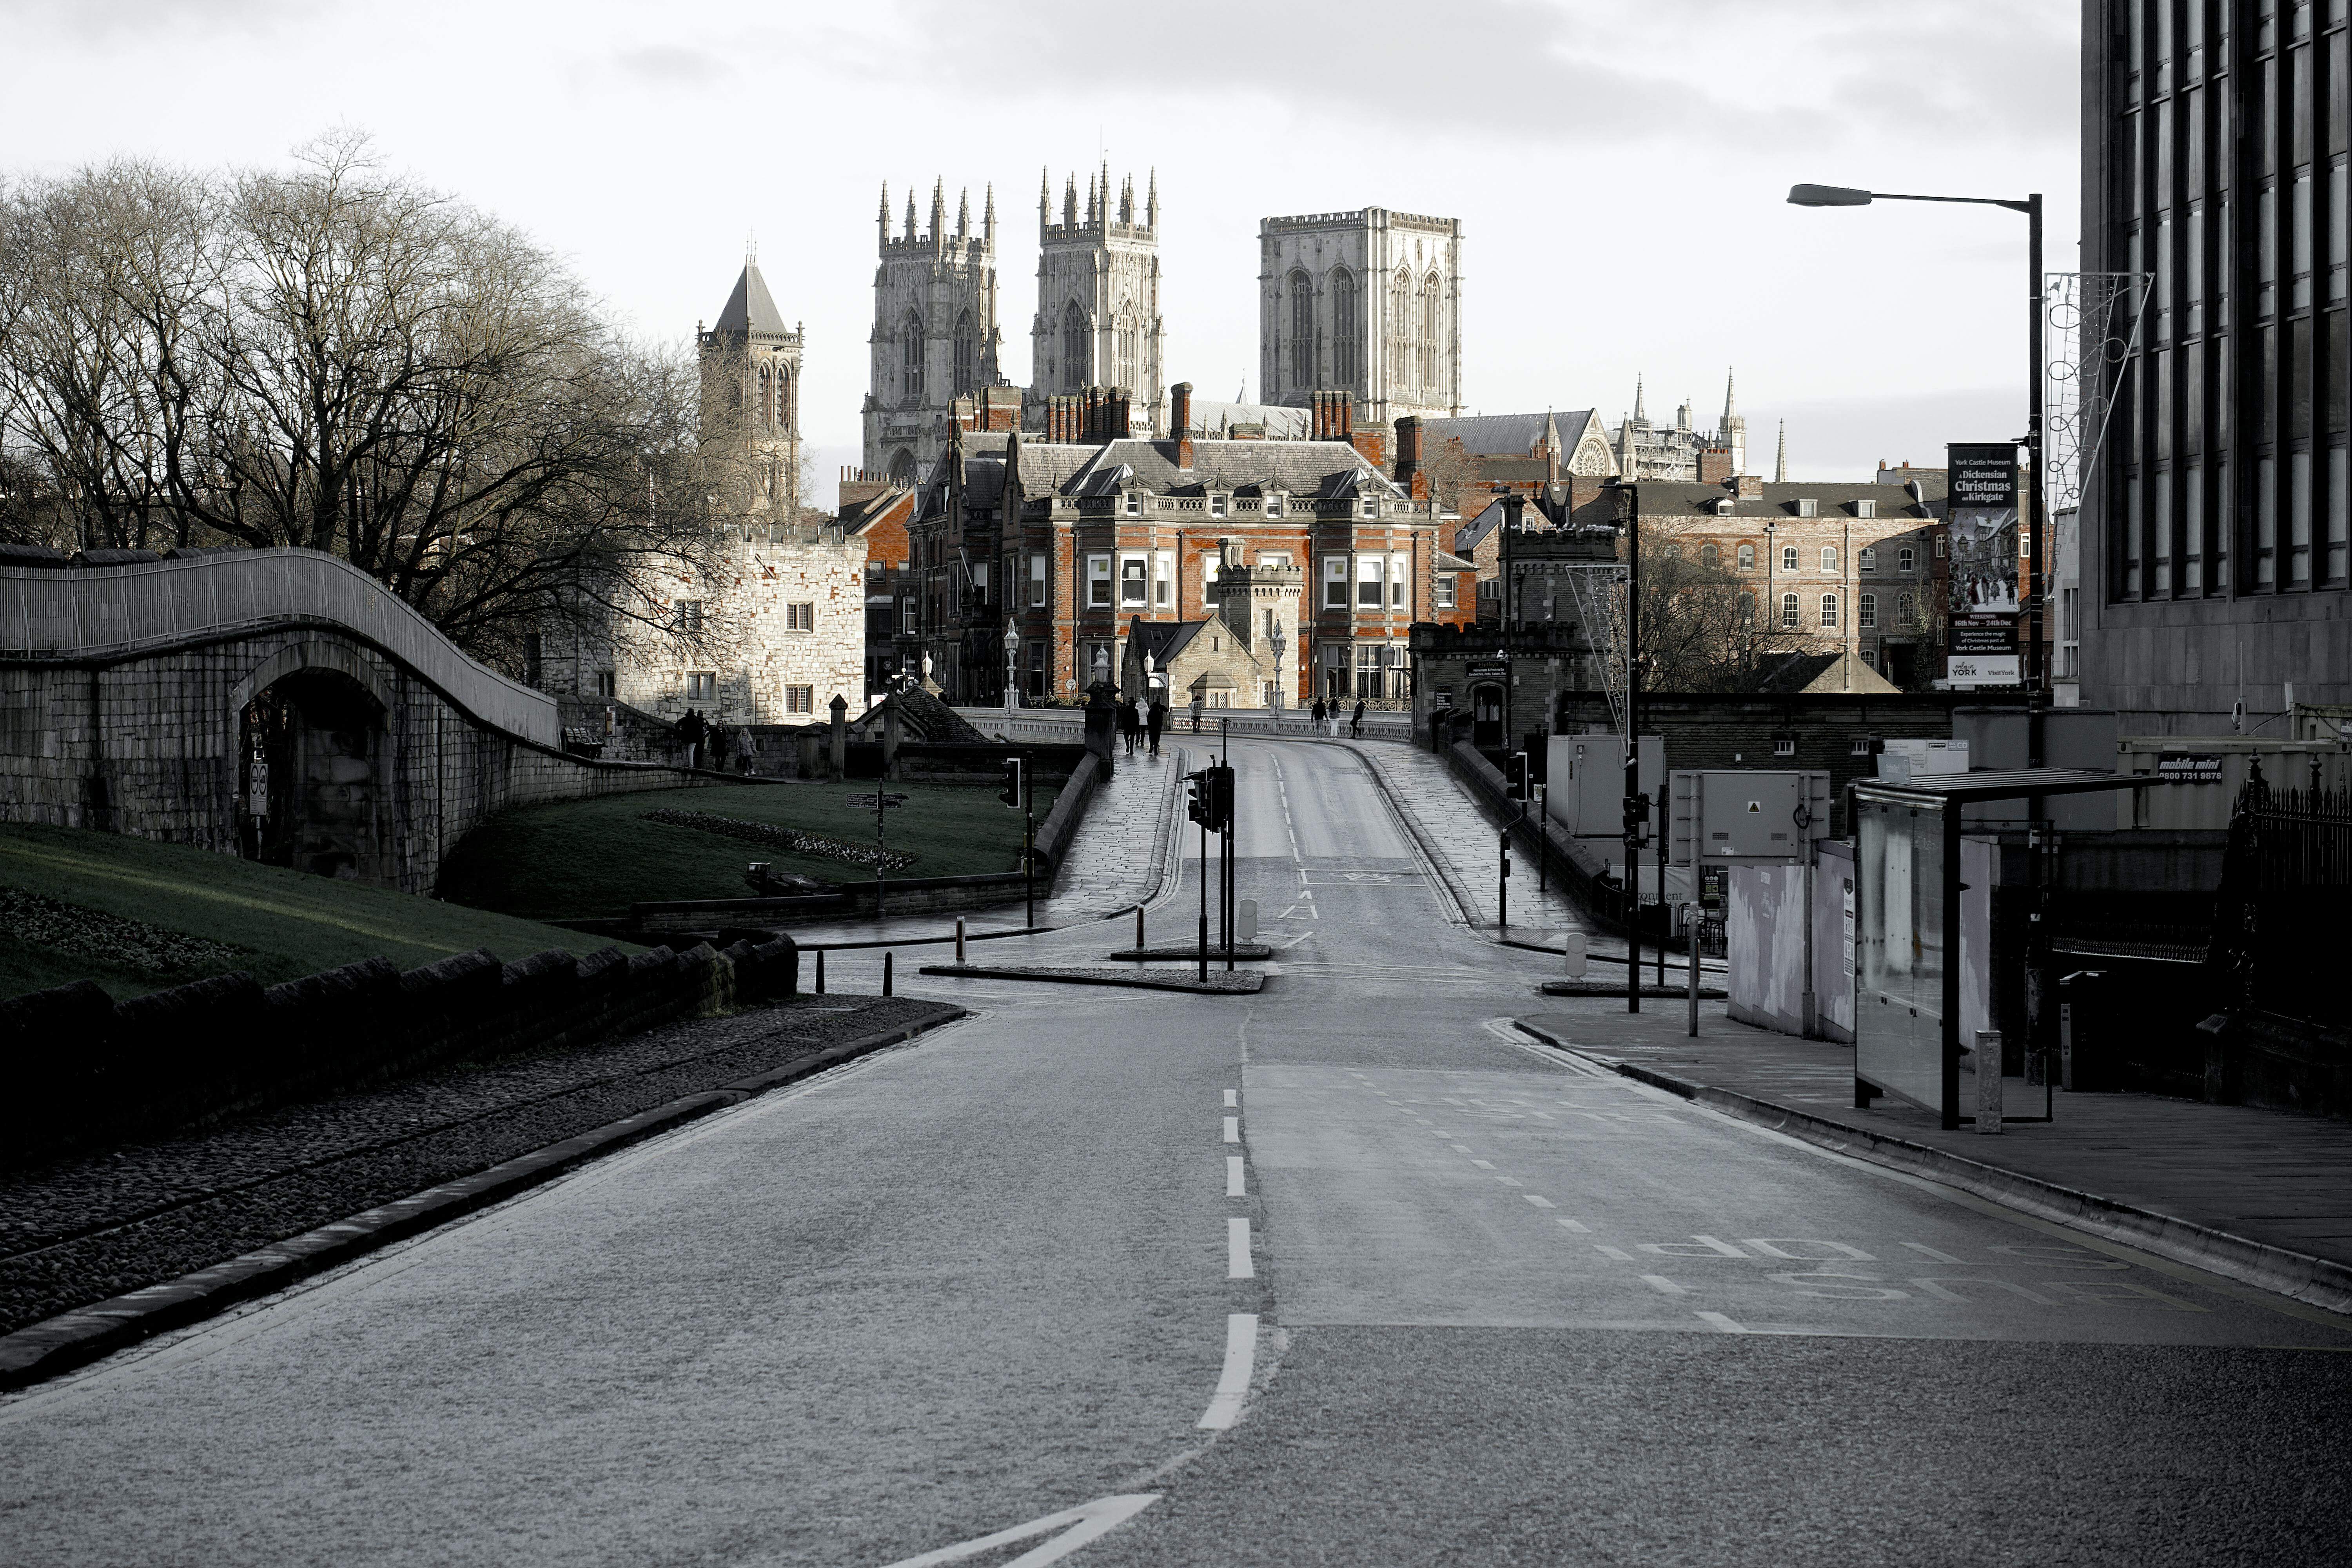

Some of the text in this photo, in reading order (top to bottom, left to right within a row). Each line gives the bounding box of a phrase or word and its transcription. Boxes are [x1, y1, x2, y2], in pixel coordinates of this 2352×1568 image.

[1963, 470, 2007, 479] Dickensian
[1955, 480, 2011, 492] Christmas
[1969, 492, 2004, 503] Kirkgate
[2159, 758, 2220, 769] mobile mini
[1637, 1236, 2131, 1269] STOP
[1766, 1273, 2214, 1312] BUS
